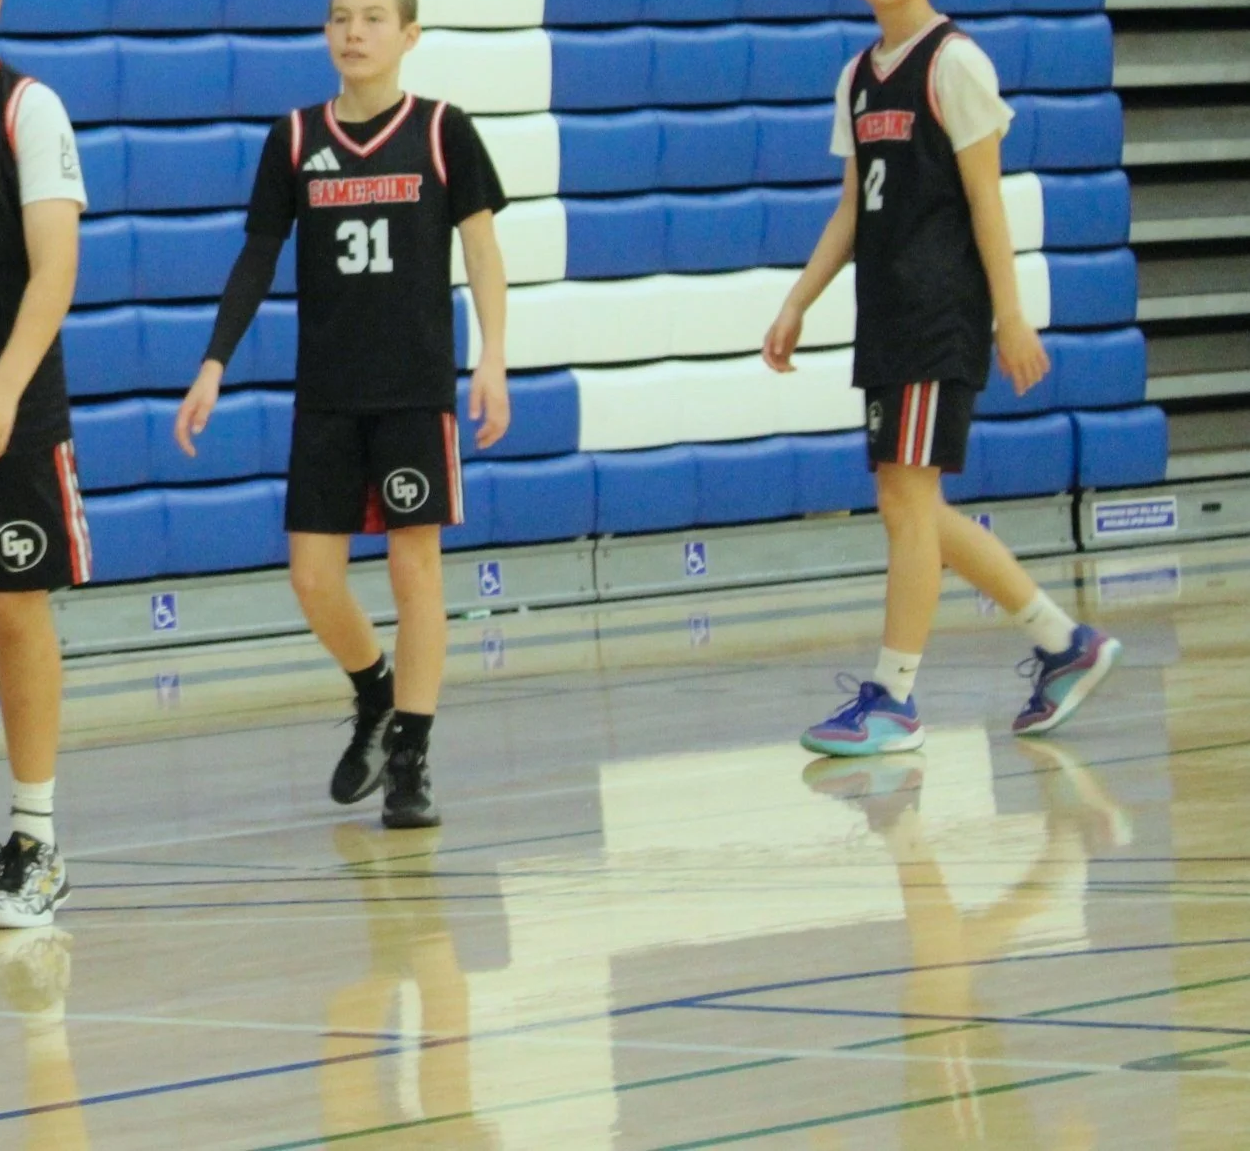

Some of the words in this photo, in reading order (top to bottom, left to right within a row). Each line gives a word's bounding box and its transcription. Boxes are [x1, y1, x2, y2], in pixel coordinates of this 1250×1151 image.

[307, 174, 423, 208] GAMEPOINT
[335, 218, 394, 274] 31
[391, 475, 418, 507] GP
[1, 530, 35, 566] GP
